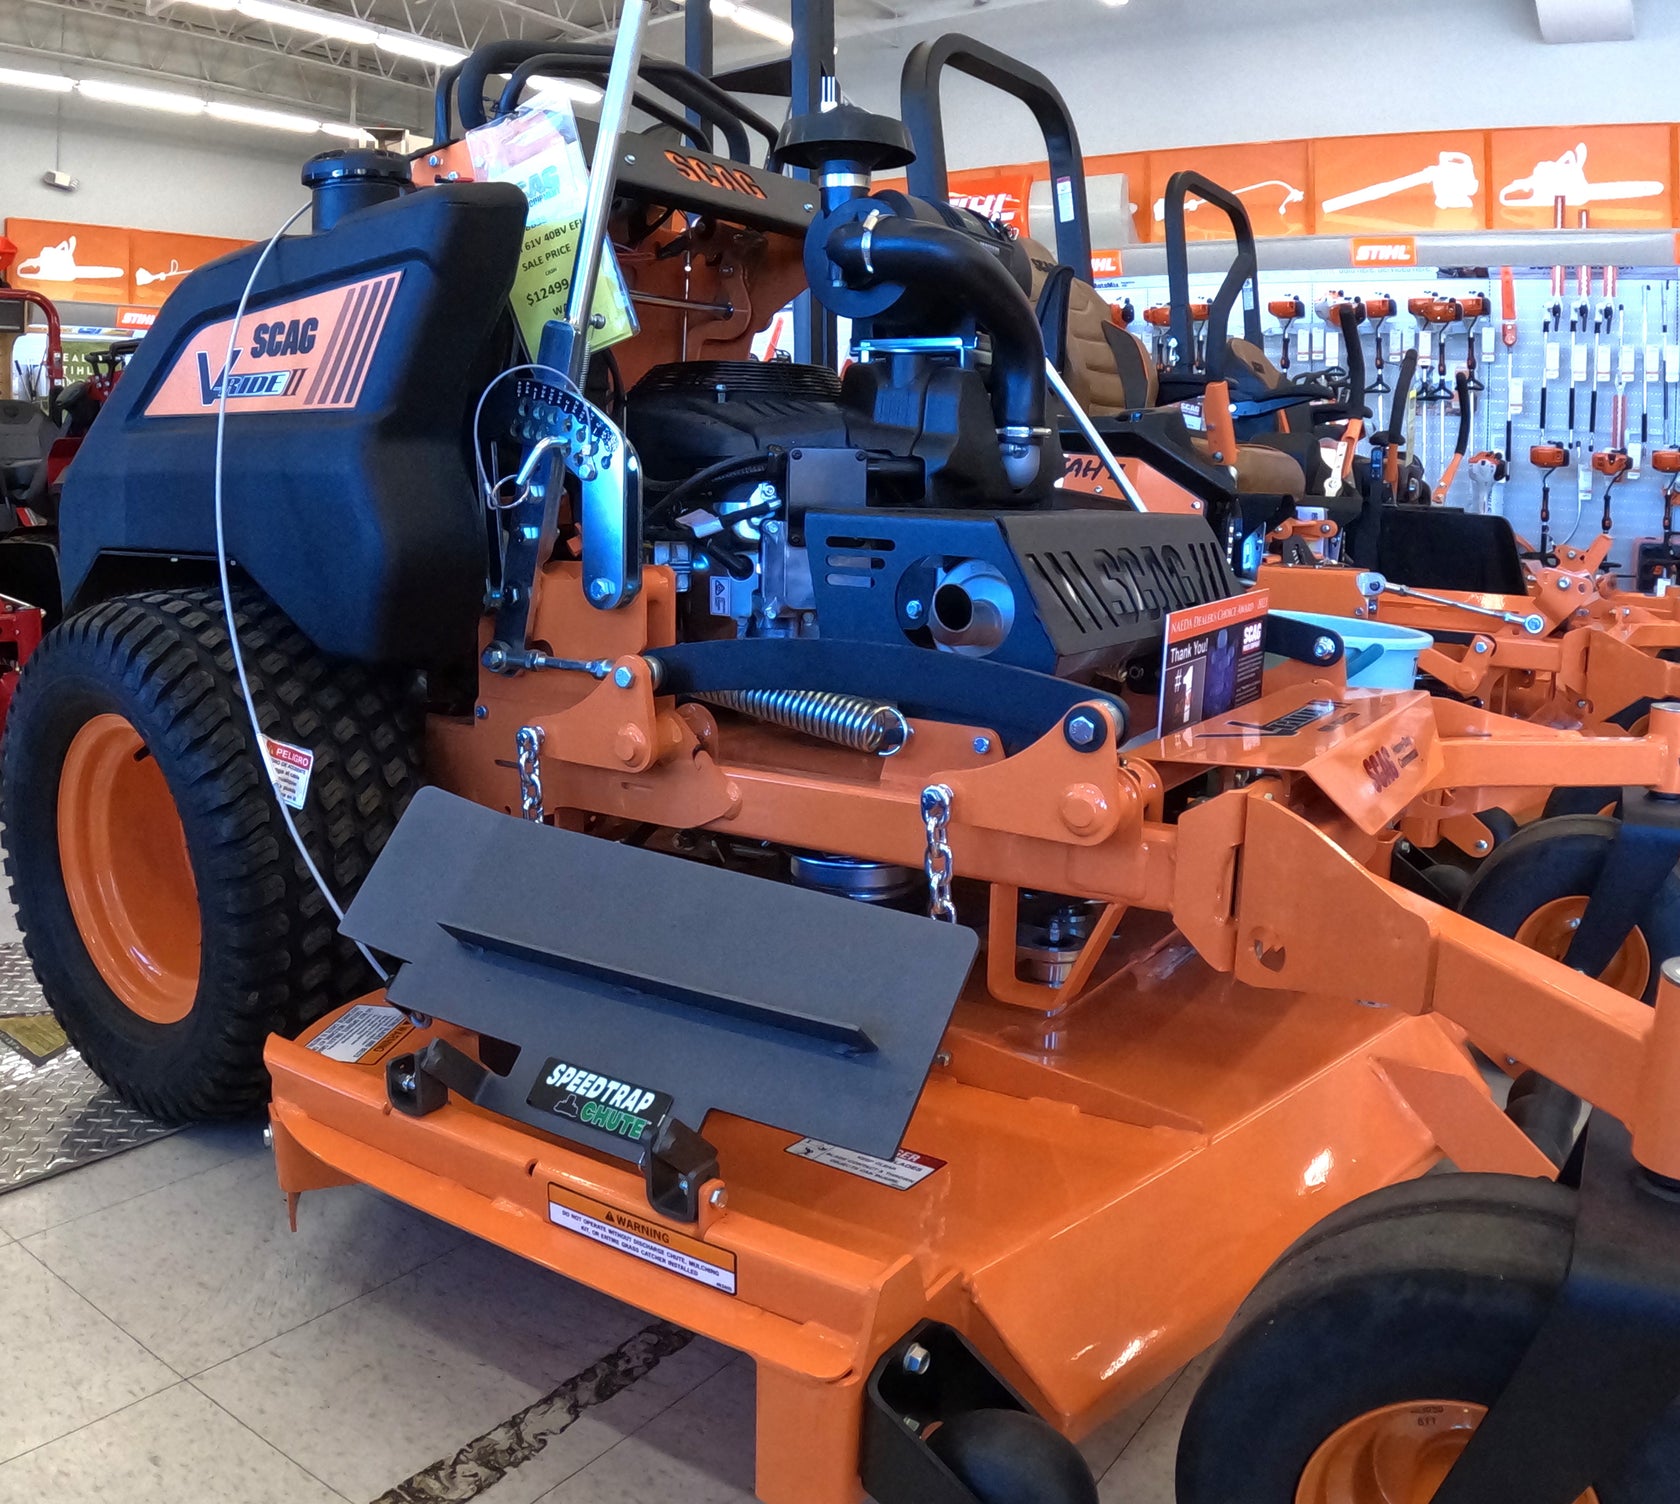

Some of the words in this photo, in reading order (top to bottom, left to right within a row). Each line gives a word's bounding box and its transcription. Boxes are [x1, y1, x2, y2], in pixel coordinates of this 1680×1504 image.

[664, 150, 768, 200] SCAG
[522, 254, 544, 272] SALE
[546, 243, 571, 262] PRICE
[524, 236, 541, 251] 61V
[1356, 245, 1410, 261] STIHL
[526, 278, 569, 307] $12499
[121, 312, 156, 325] STIH
[250, 317, 319, 359] SCAG
[62, 353, 87, 362] EAL
[62, 365, 94, 376] TIHL
[1094, 544, 1202, 625] SCAG
[1217, 607, 1237, 621] CHOICE
[1243, 623, 1262, 645] SCAG
[1171, 643, 1191, 664] Thank
[1193, 638, 1209, 654] You!
[276, 748, 309, 767] PELIGRO
[546, 1063, 656, 1114] SPEEDTRAP
[580, 1101, 648, 1140] CHUTE
[562, 1209, 570, 1217] DO
[571, 1212, 582, 1222] NOT
[583, 1217, 607, 1233] OPERATE
[608, 1227, 632, 1243] WITHOUT
[633, 1236, 664, 1256] DISCHARGE
[688, 1259, 720, 1277] MULCHING
[616, 1214, 670, 1244] WARNING
[592, 1229, 600, 1237] OR
[600, 1232, 620, 1246] ENTIRE
[621, 1241, 639, 1254] GRASS
[640, 1249, 667, 1265] CATCHER
[667, 1260, 698, 1278] INSTALLED
